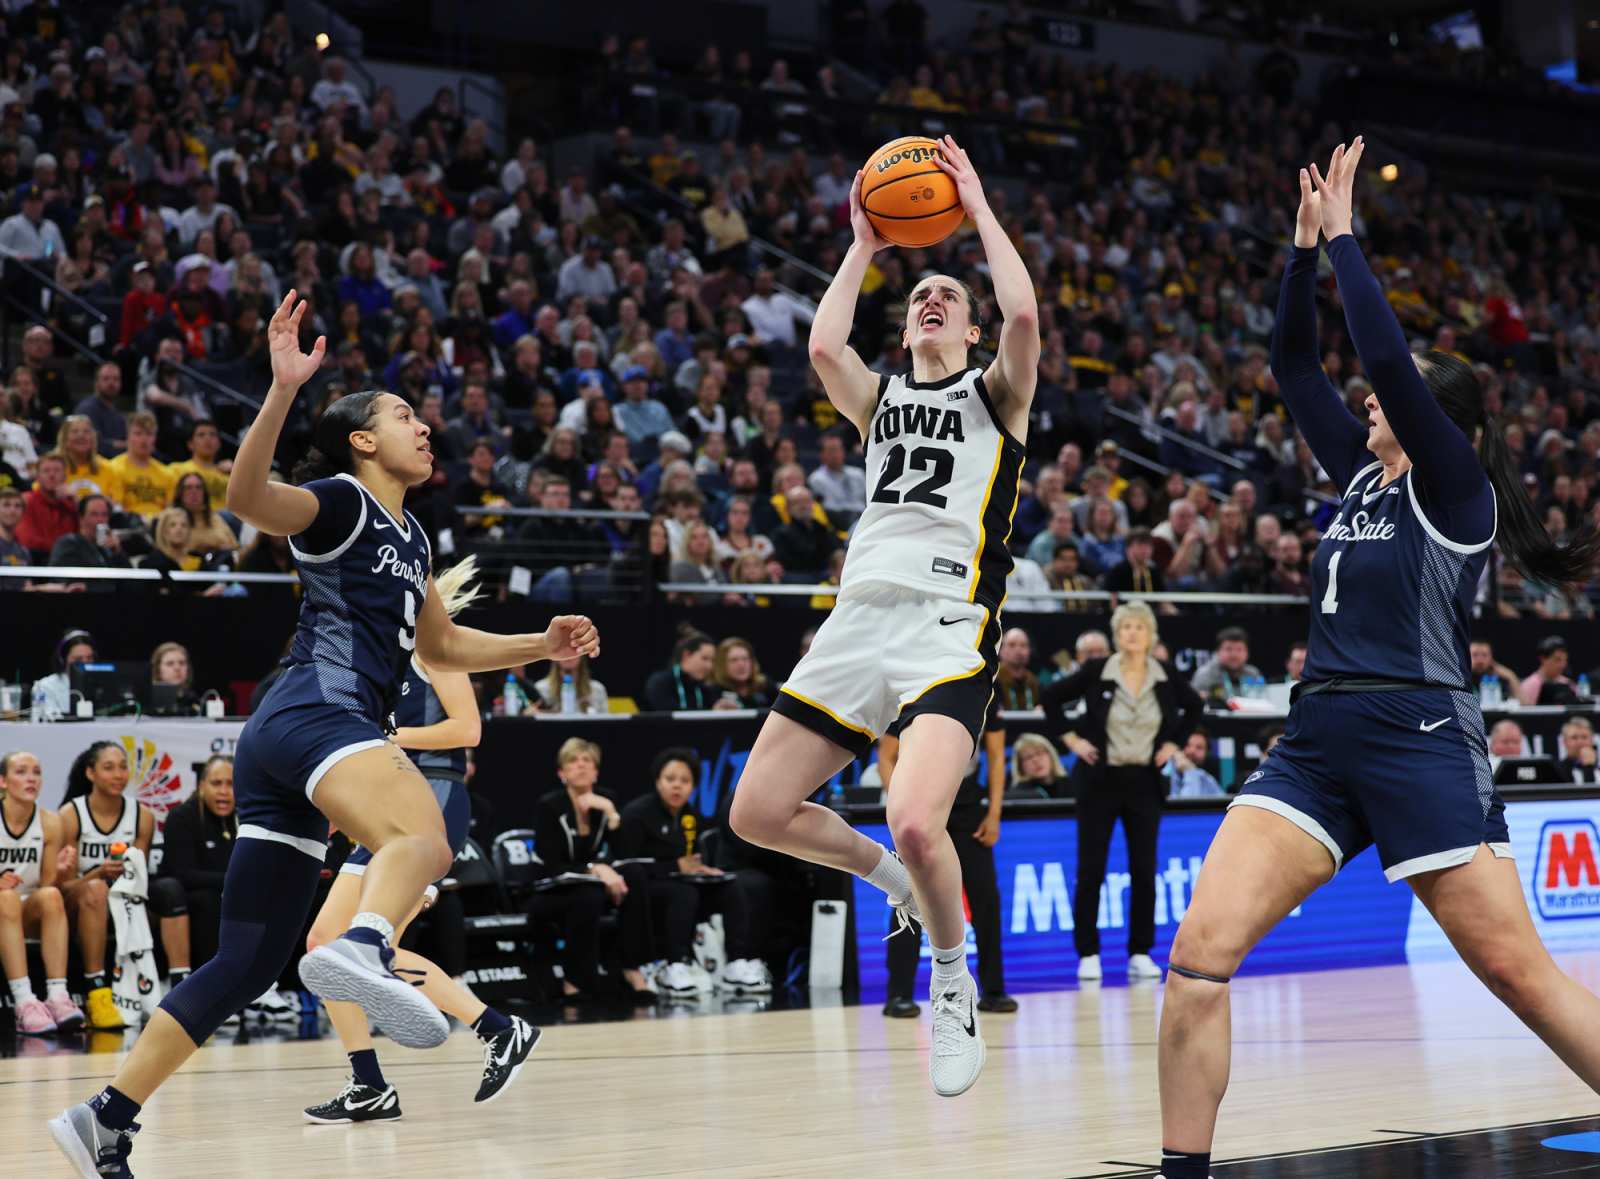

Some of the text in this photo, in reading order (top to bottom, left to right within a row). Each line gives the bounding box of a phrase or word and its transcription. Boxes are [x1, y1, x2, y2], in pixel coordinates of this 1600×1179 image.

[874, 403, 965, 444] IOWA
[870, 443, 955, 510] 22
[1321, 551, 1341, 614] 1
